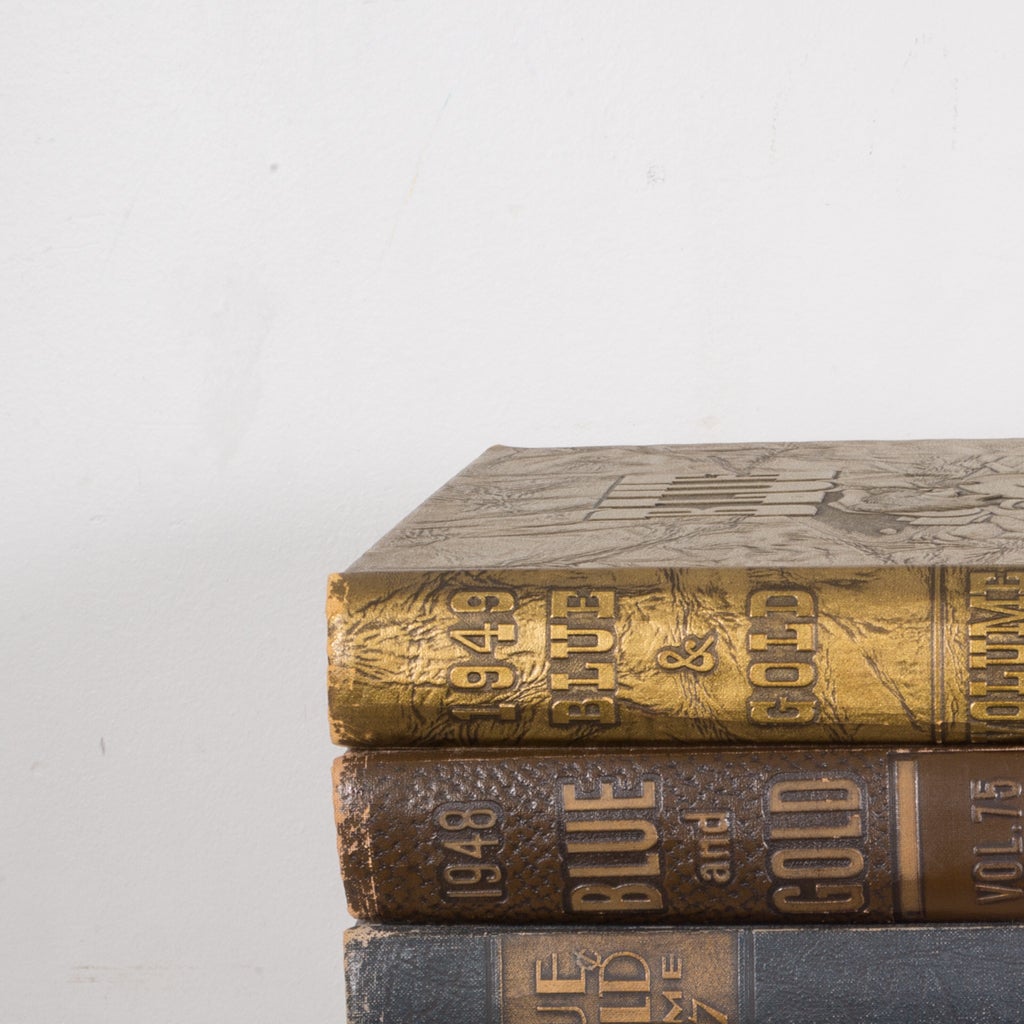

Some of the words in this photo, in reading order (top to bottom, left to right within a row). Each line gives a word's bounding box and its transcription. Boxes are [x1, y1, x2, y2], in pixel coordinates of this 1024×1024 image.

[451, 588, 516, 723] 1949
[551, 588, 616, 726] BLUE
[657, 633, 718, 673] &
[747, 588, 817, 726] GOLD
[439, 804, 501, 901] 1948
[562, 780, 664, 912] BLUE
[684, 811, 732, 883] and
[769, 778, 865, 913] GOLD
